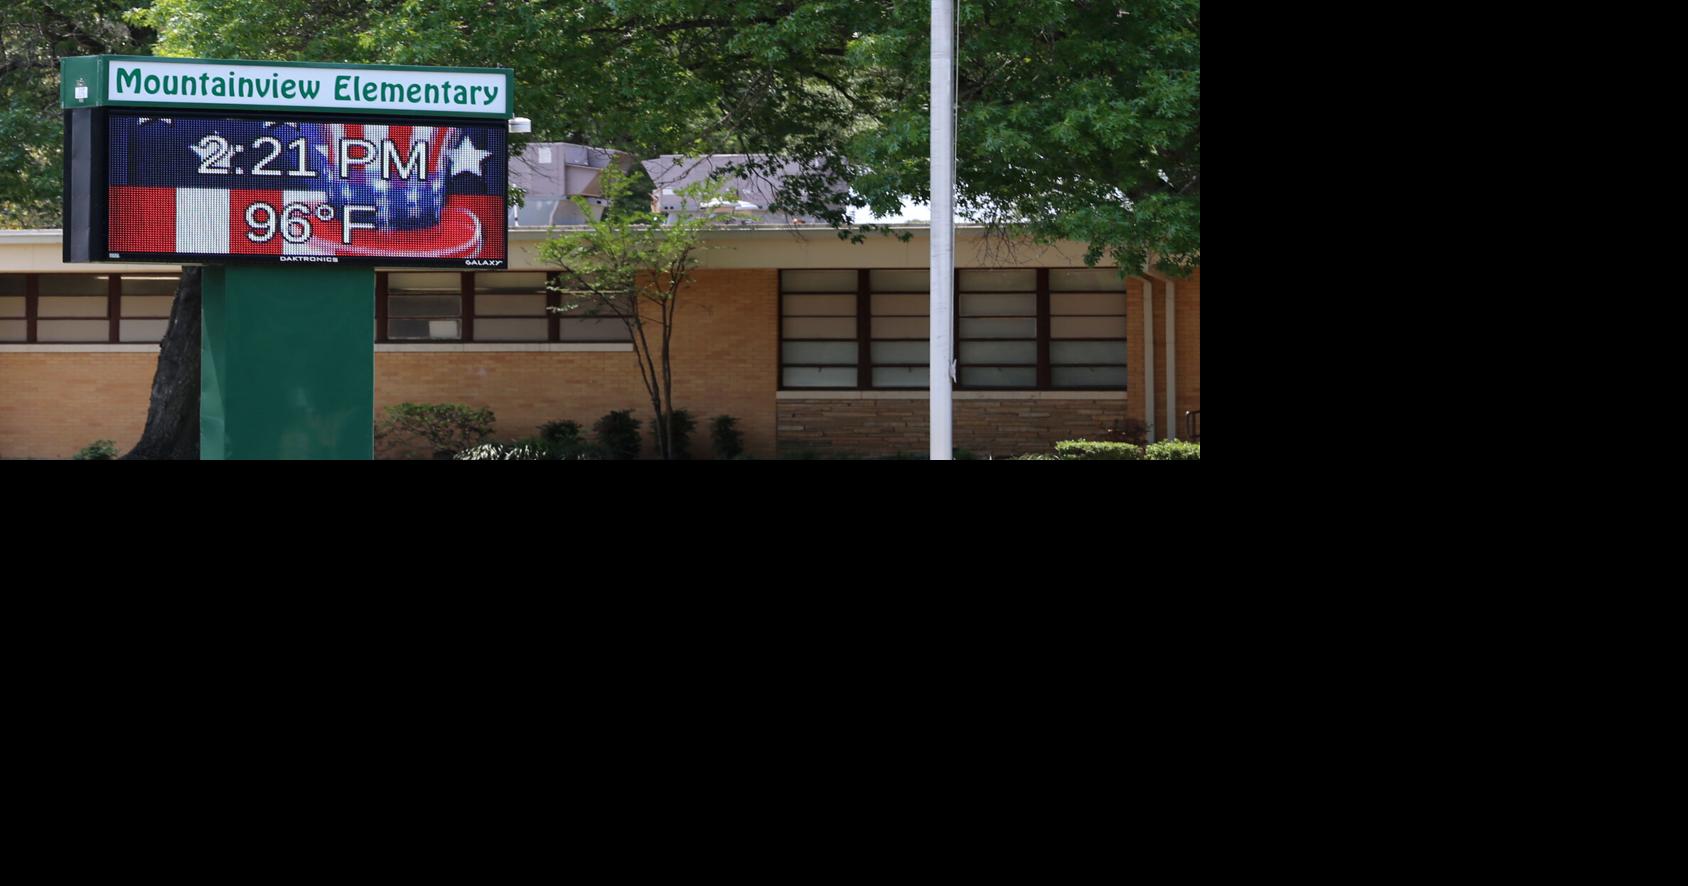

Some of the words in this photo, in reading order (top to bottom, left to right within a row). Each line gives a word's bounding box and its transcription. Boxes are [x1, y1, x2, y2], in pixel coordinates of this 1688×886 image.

[116, 67, 320, 101] Mountainview
[334, 75, 498, 106] Elementary
[196, 134, 318, 177] 2:21
[338, 138, 428, 182] PM
